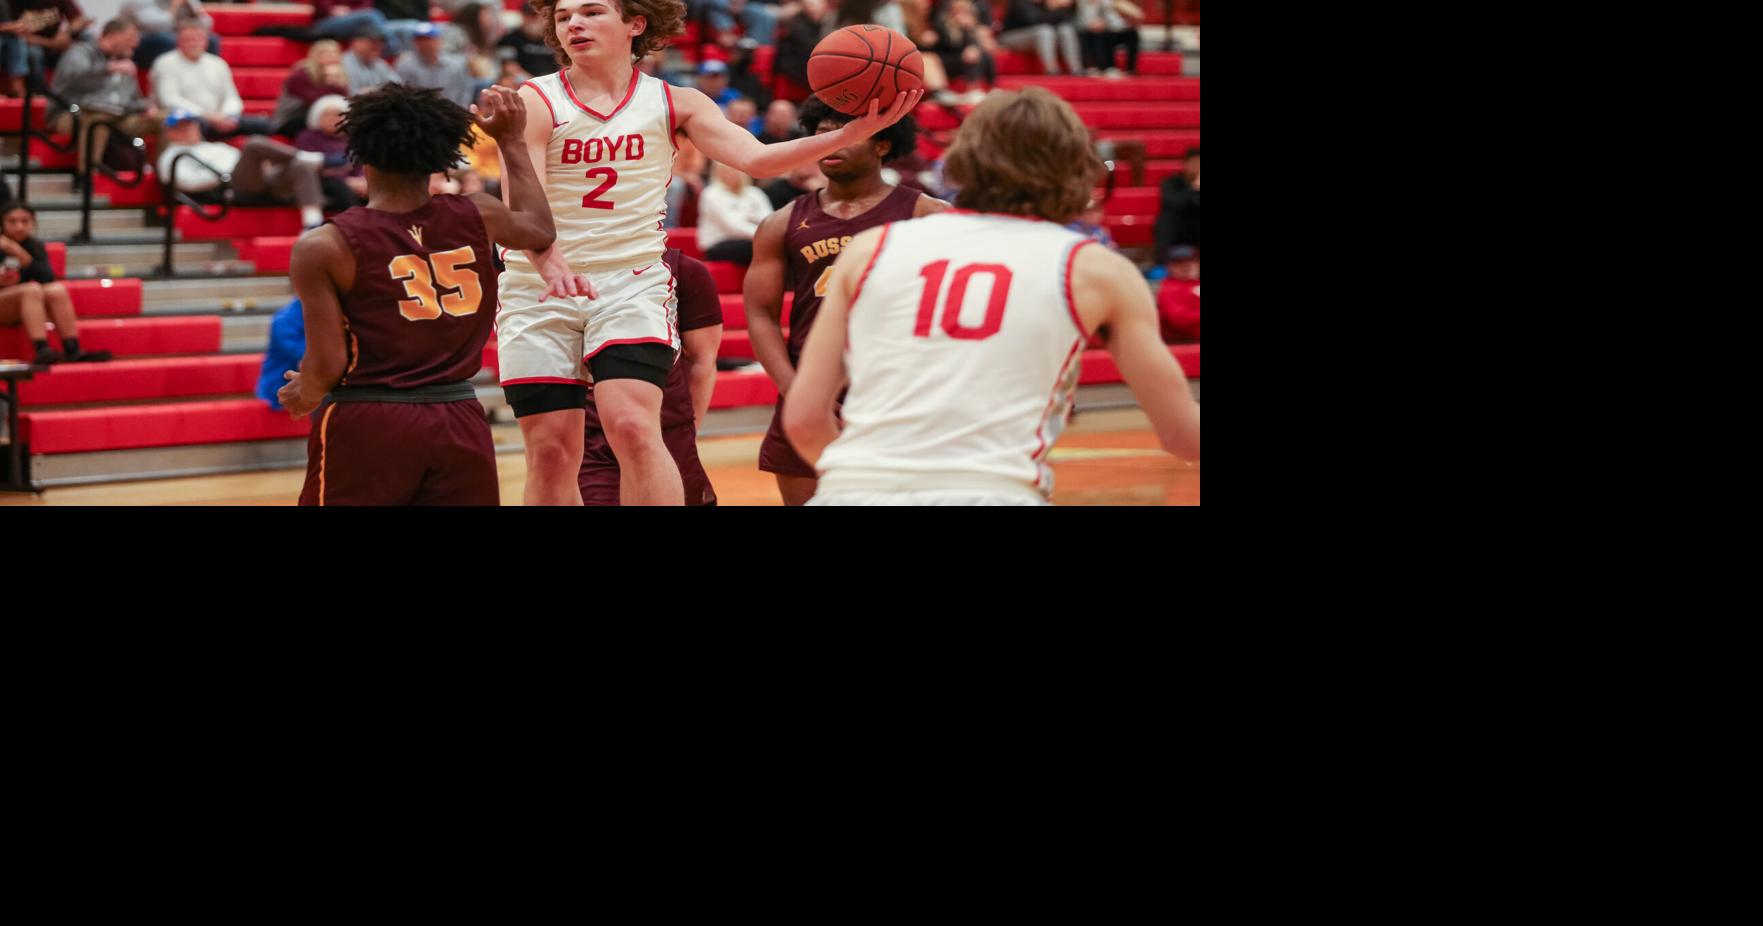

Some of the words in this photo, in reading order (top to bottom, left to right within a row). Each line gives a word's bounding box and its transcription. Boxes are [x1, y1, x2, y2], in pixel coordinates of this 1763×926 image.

[561, 134, 645, 165] BOYD
[582, 167, 618, 210] 2
[388, 245, 483, 321] 35
[913, 259, 1012, 341] 10
